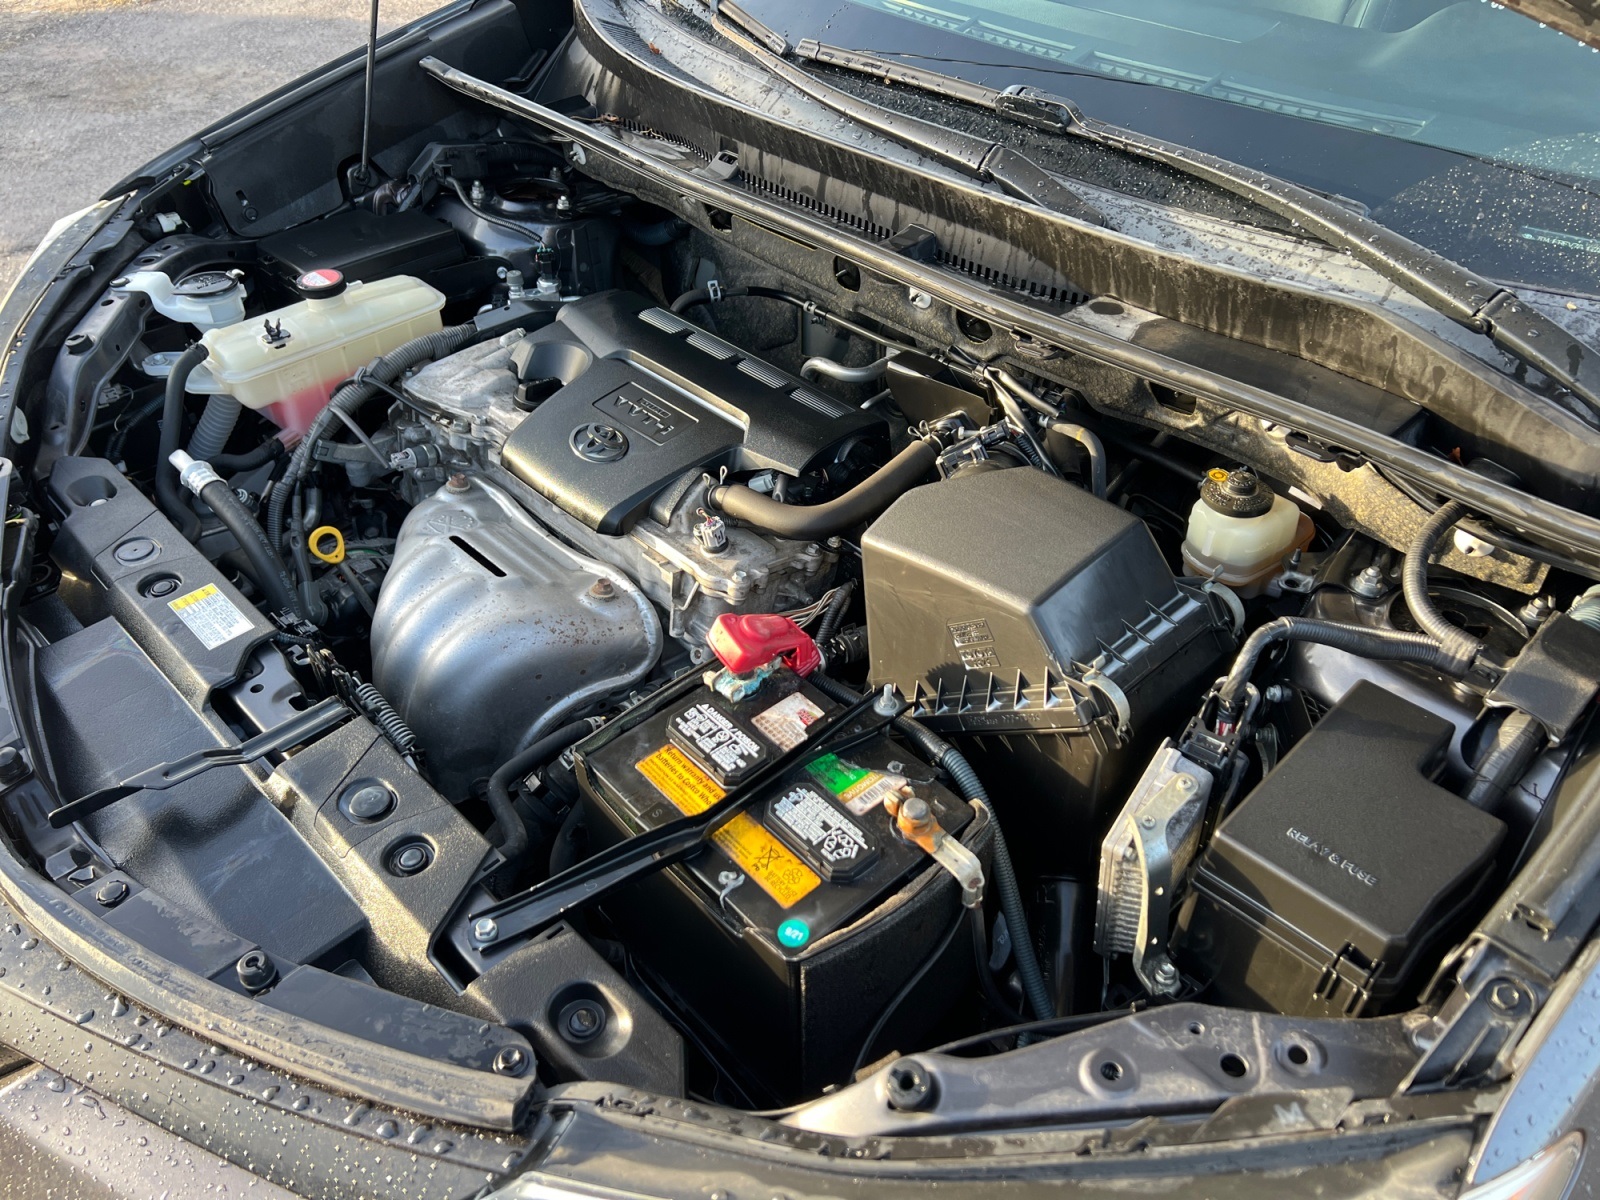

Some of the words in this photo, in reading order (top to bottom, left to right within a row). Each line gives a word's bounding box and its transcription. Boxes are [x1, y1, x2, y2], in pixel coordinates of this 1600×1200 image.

[655, 753, 678, 775] batteries
[676, 773, 684, 781] to
[682, 778, 700, 795] Costco
[665, 746, 683, 766] Return
[681, 763, 704, 785] warranty
[702, 782, 716, 794] and
[1286, 827, 1331, 856] RELAY
[1340, 859, 1379, 886] FUSE
